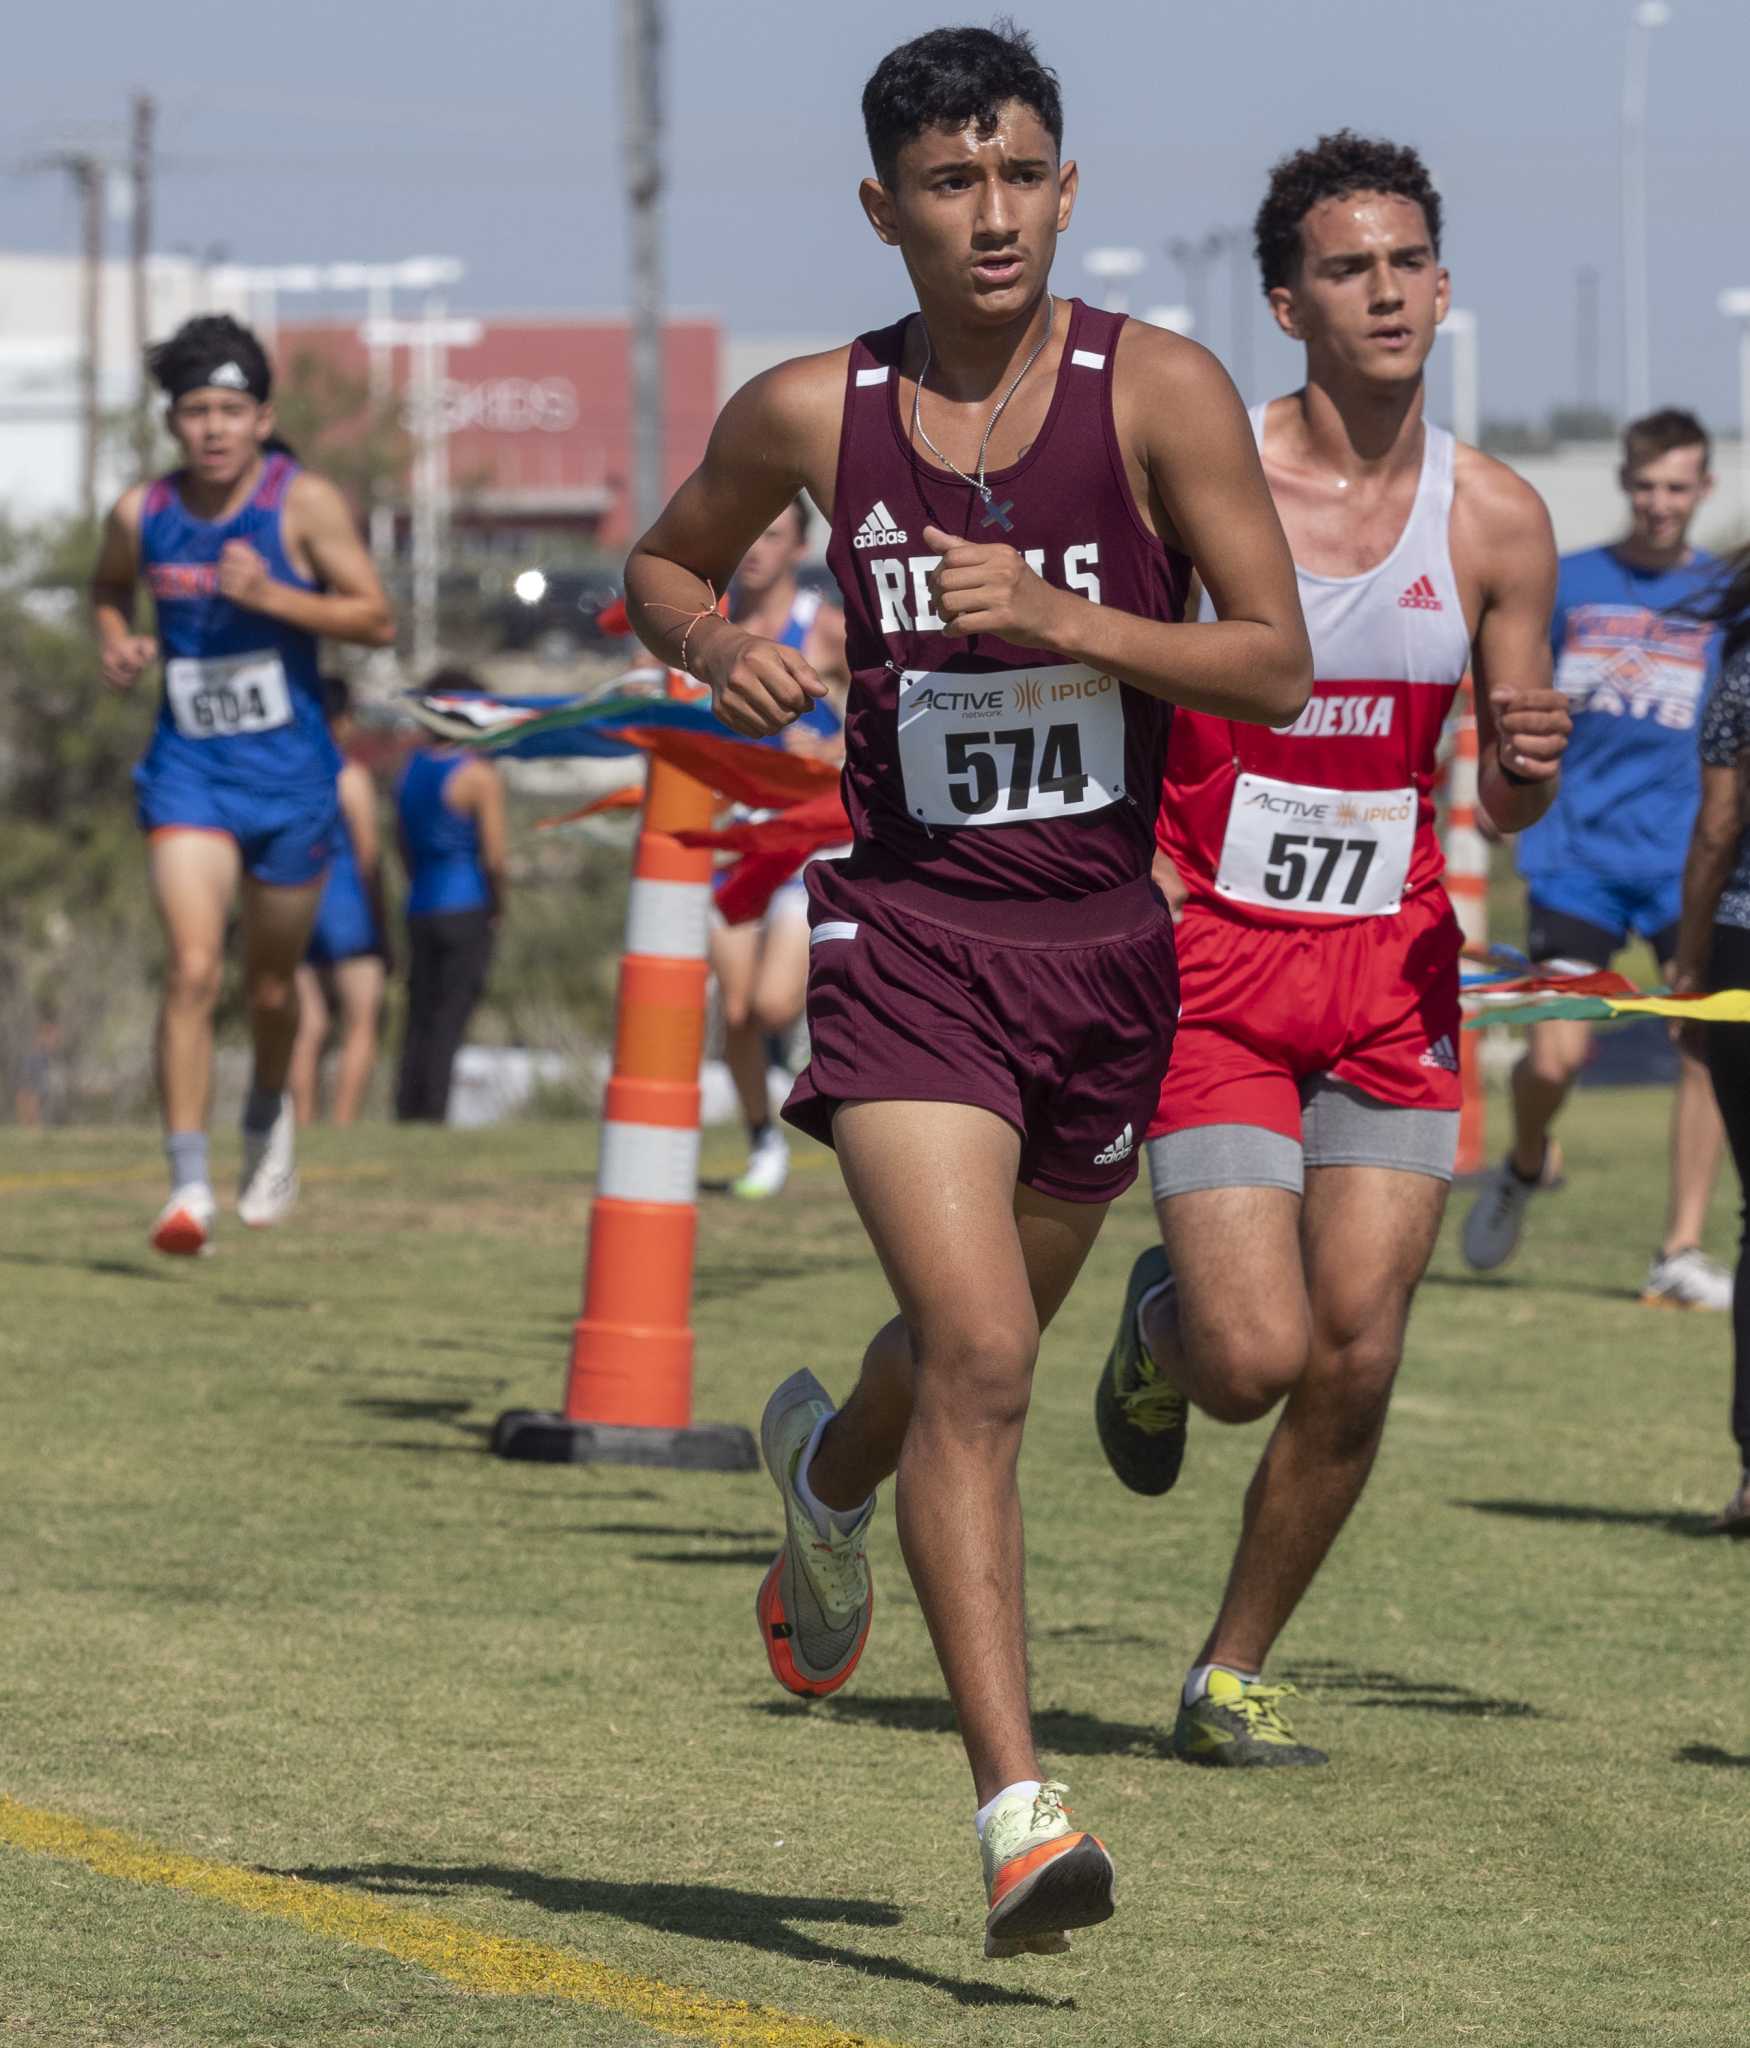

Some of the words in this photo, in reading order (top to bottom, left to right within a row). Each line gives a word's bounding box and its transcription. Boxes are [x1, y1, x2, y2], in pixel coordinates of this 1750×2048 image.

[853, 529, 908, 549] adidas
[870, 543, 1101, 634] RES
[192, 686, 266, 726] 604
[909, 688, 1004, 710] ACTIVE
[1050, 675, 1112, 702] IPICO
[961, 709, 1004, 720] network
[1268, 696, 1396, 737] DESSA
[944, 723, 1089, 816] 574
[1246, 792, 1330, 819] ACTIVE
[1361, 803, 1410, 822] IPICO
[1263, 832, 1378, 905] 577
